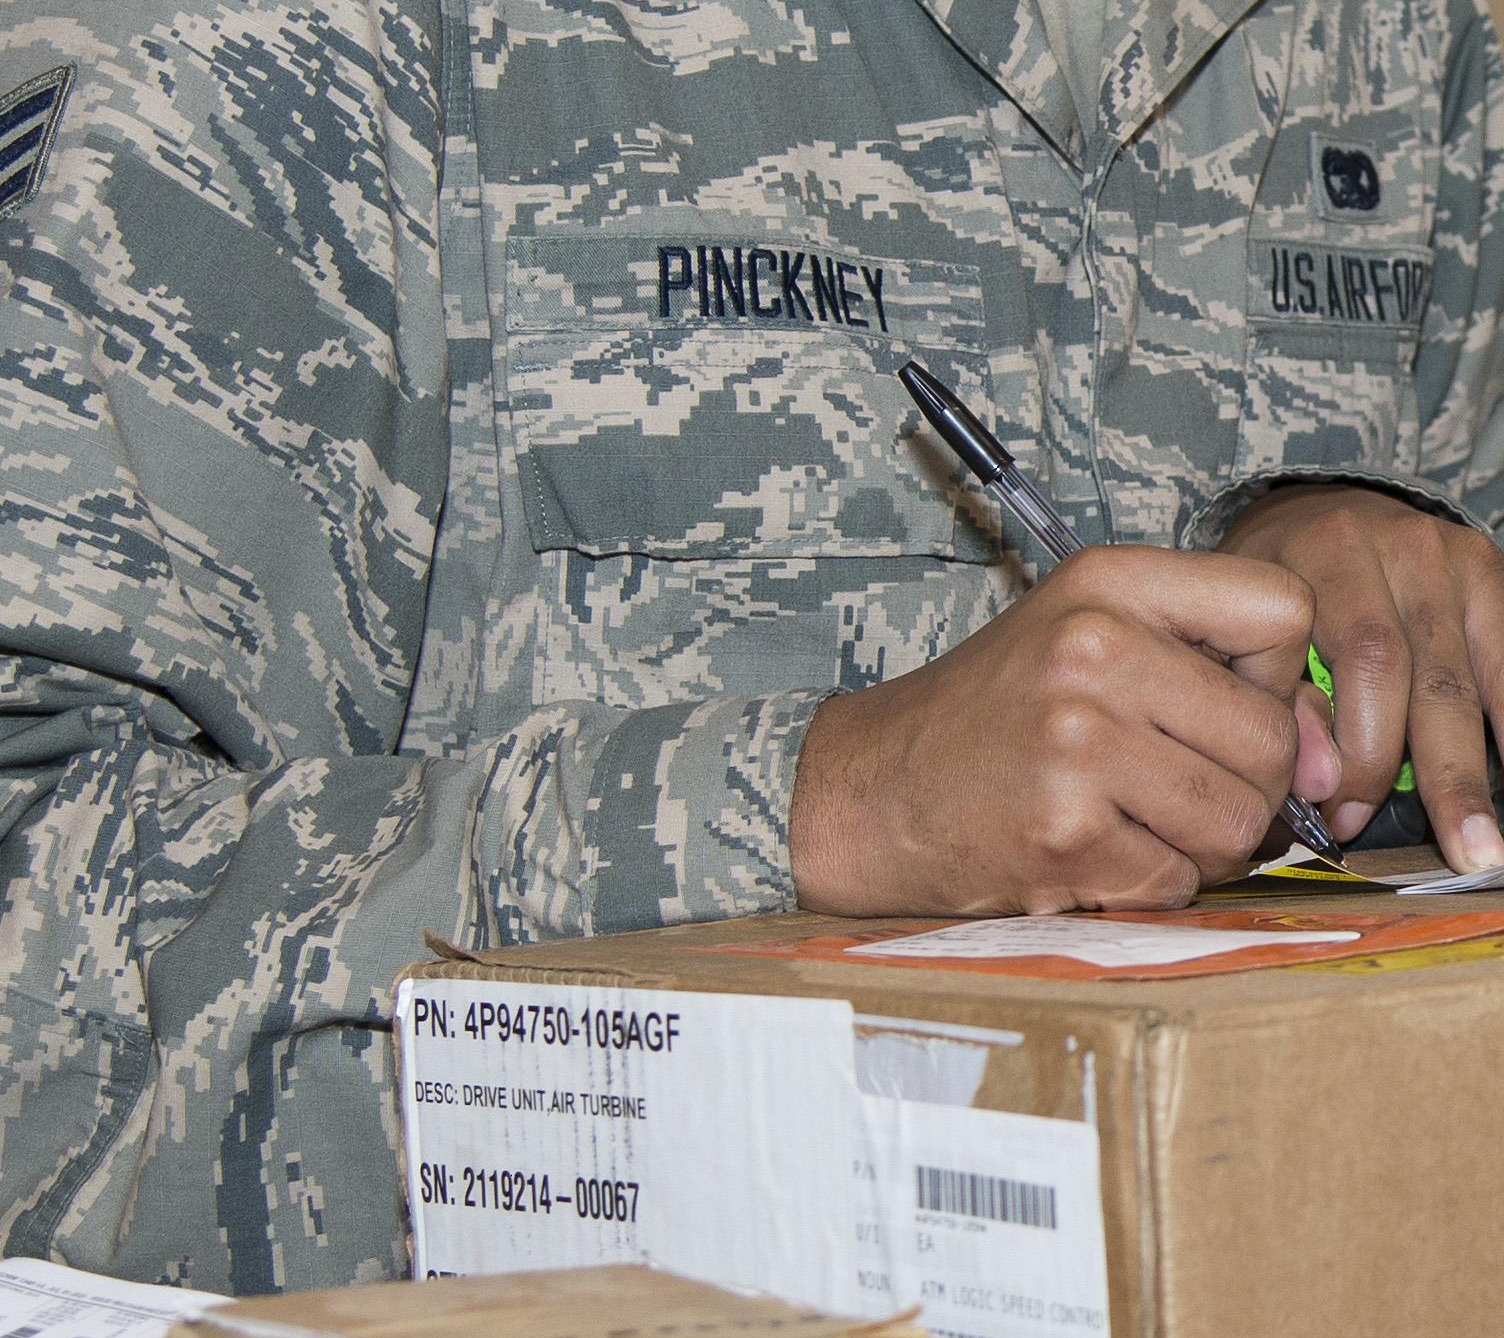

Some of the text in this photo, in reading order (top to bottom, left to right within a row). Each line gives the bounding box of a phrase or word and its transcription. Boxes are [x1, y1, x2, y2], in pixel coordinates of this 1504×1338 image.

[658, 245, 888, 332] PINCKNEY
[414, 998, 680, 1052] PN: 4P94750-105AGF
[415, 1081, 458, 1105] DESC:
[463, 1085, 507, 1109] DRIVE
[580, 1093, 647, 1120] TURBINE
[420, 1162, 455, 1205] SN:
[920, 1280, 945, 1301] ATM
[952, 1286, 993, 1311] LOGIC
[1000, 1293, 1044, 1320] SPEED
